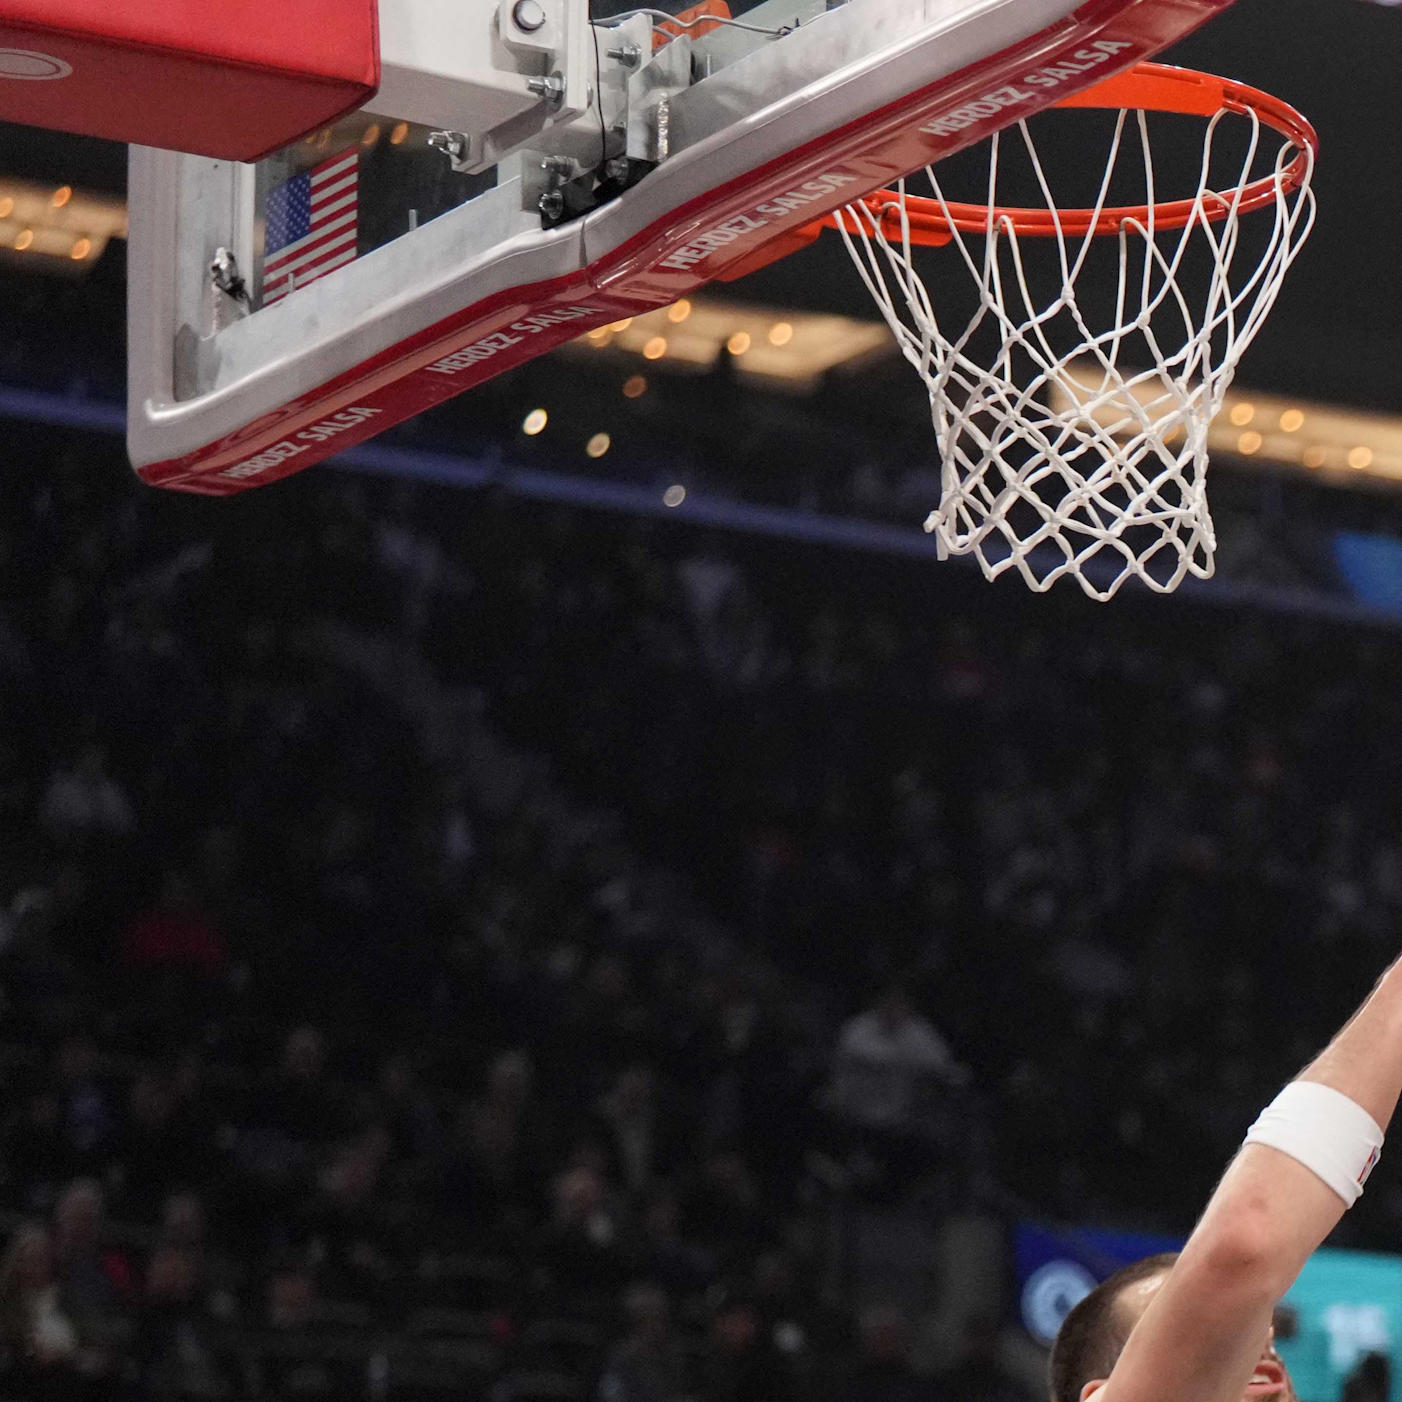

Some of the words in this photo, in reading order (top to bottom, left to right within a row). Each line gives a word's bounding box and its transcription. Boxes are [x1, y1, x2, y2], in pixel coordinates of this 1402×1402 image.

[919, 85, 1036, 137] HERDEZ
[1023, 39, 1134, 88] SALSA
[659, 215, 769, 270] HERDEZ
[756, 171, 858, 217] SALSA
[425, 332, 526, 375] HERDEZ
[509, 305, 604, 334] SALSA
[296, 406, 383, 442] SALSA
